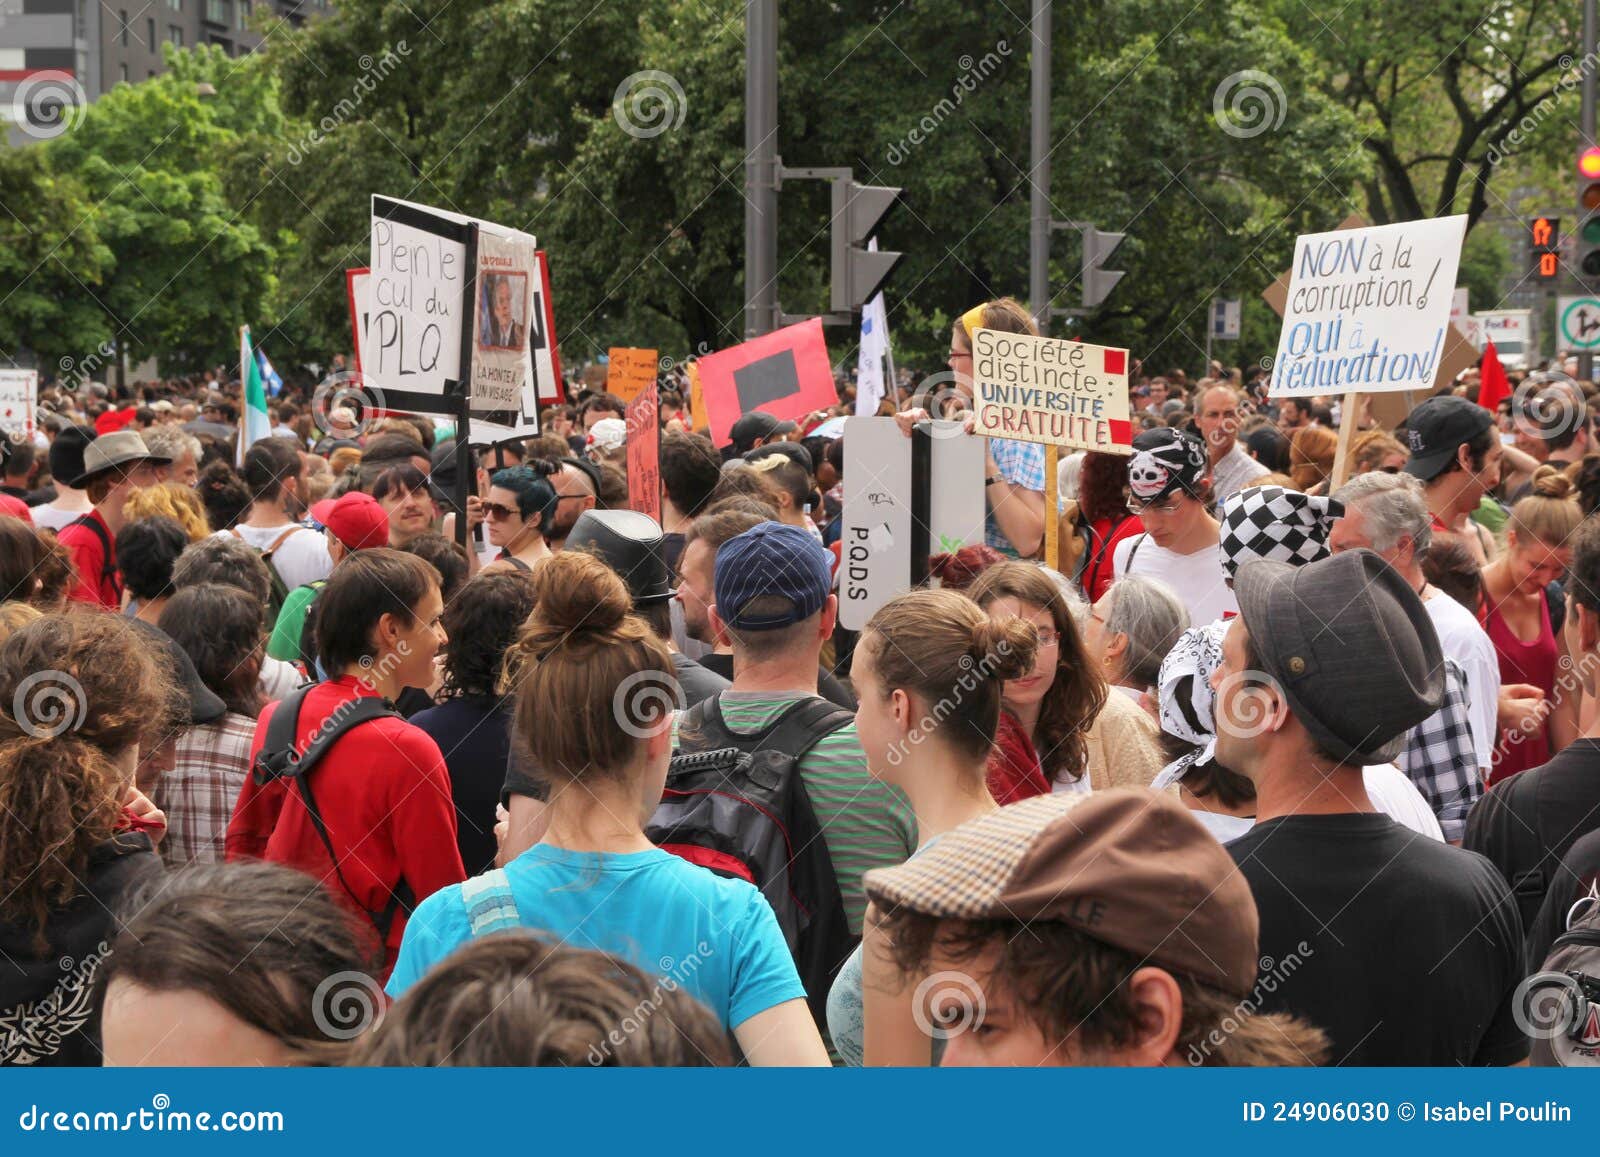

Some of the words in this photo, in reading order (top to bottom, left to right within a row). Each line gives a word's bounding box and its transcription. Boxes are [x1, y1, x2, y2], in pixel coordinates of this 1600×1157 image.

[374, 221, 430, 278] Plein
[438, 238, 457, 280] le
[1299, 236, 1367, 279] NON
[1369, 243, 1384, 272] à
[1391, 233, 1413, 270] la
[376, 275, 413, 313] cul
[425, 287, 450, 316] du
[373, 310, 442, 376] PLQ
[977, 331, 1086, 369] Société
[981, 404, 1107, 446] GRATUITE
